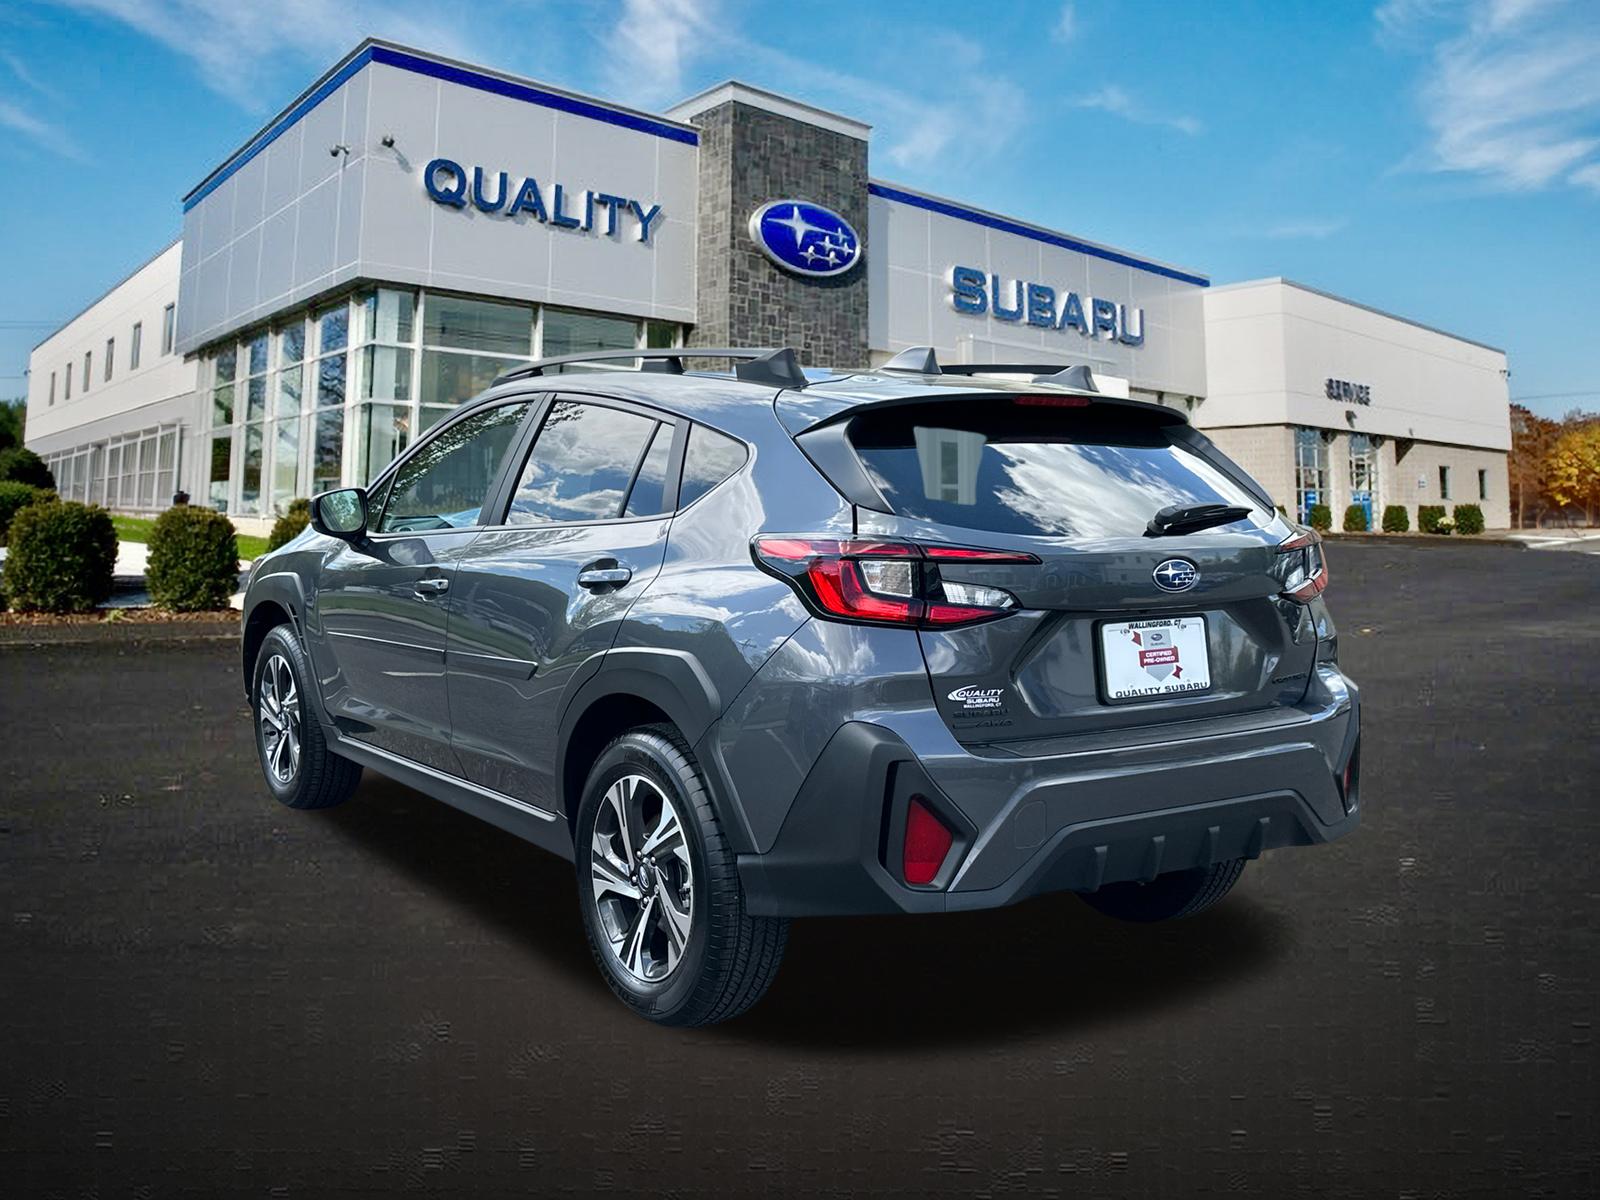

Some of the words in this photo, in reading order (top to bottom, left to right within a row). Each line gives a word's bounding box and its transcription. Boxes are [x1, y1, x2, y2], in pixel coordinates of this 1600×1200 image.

[424, 158, 662, 242] QUALITY
[951, 265, 1145, 346] SUBARU
[1325, 378, 1371, 406] SERVICE
[1143, 656, 1176, 664] PRE-OWNED
[958, 688, 1004, 697] QUALITY
[1115, 686, 1161, 698] QUALITY
[1164, 681, 1208, 694] SUBARU
